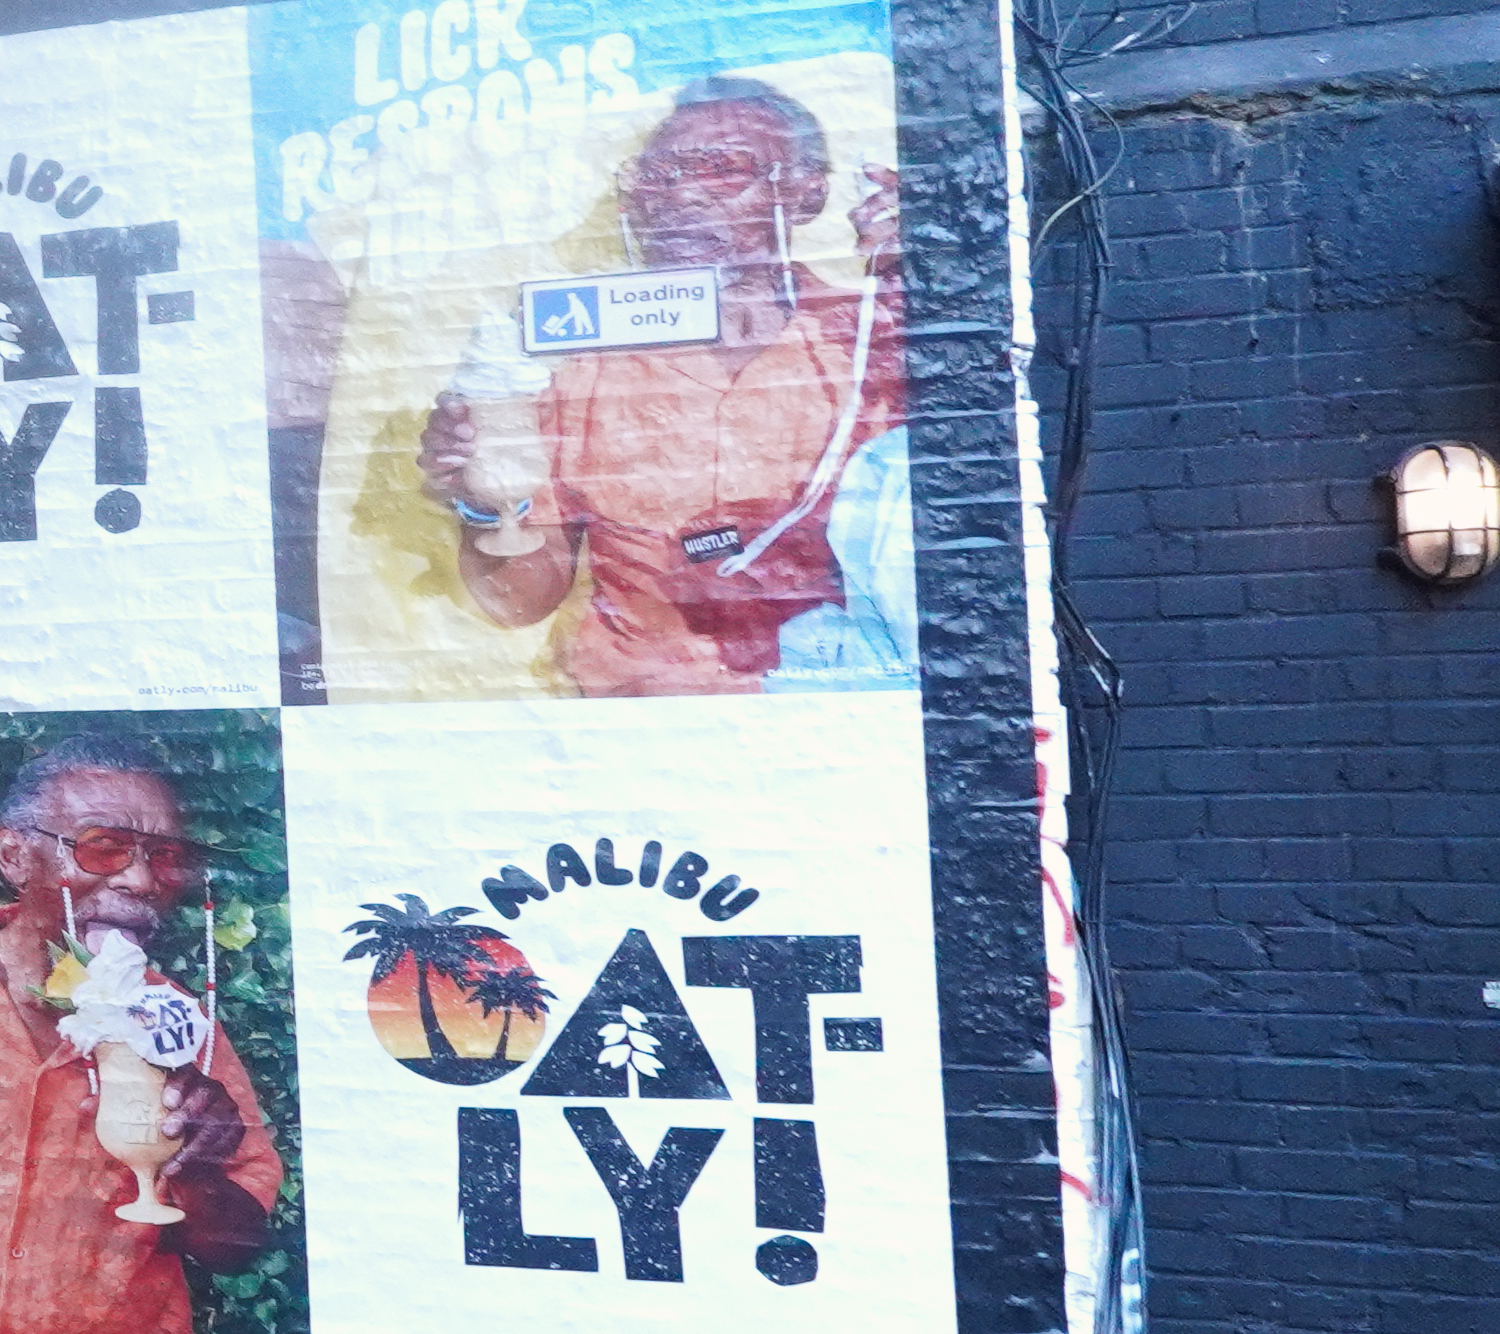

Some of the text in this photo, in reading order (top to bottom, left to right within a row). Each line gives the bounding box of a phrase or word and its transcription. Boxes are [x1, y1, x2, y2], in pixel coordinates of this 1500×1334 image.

[279, 32, 641, 222] RESPONS
[609, 283, 706, 306] Loading
[630, 309, 682, 329] only
[684, 530, 739, 554] HUSTLER
[138, 682, 259, 698] oatly.com/malibu
[481, 837, 761, 922] MALIBU
[152, 1022, 195, 1056] LY!
[457, 1105, 827, 1287] LY!
